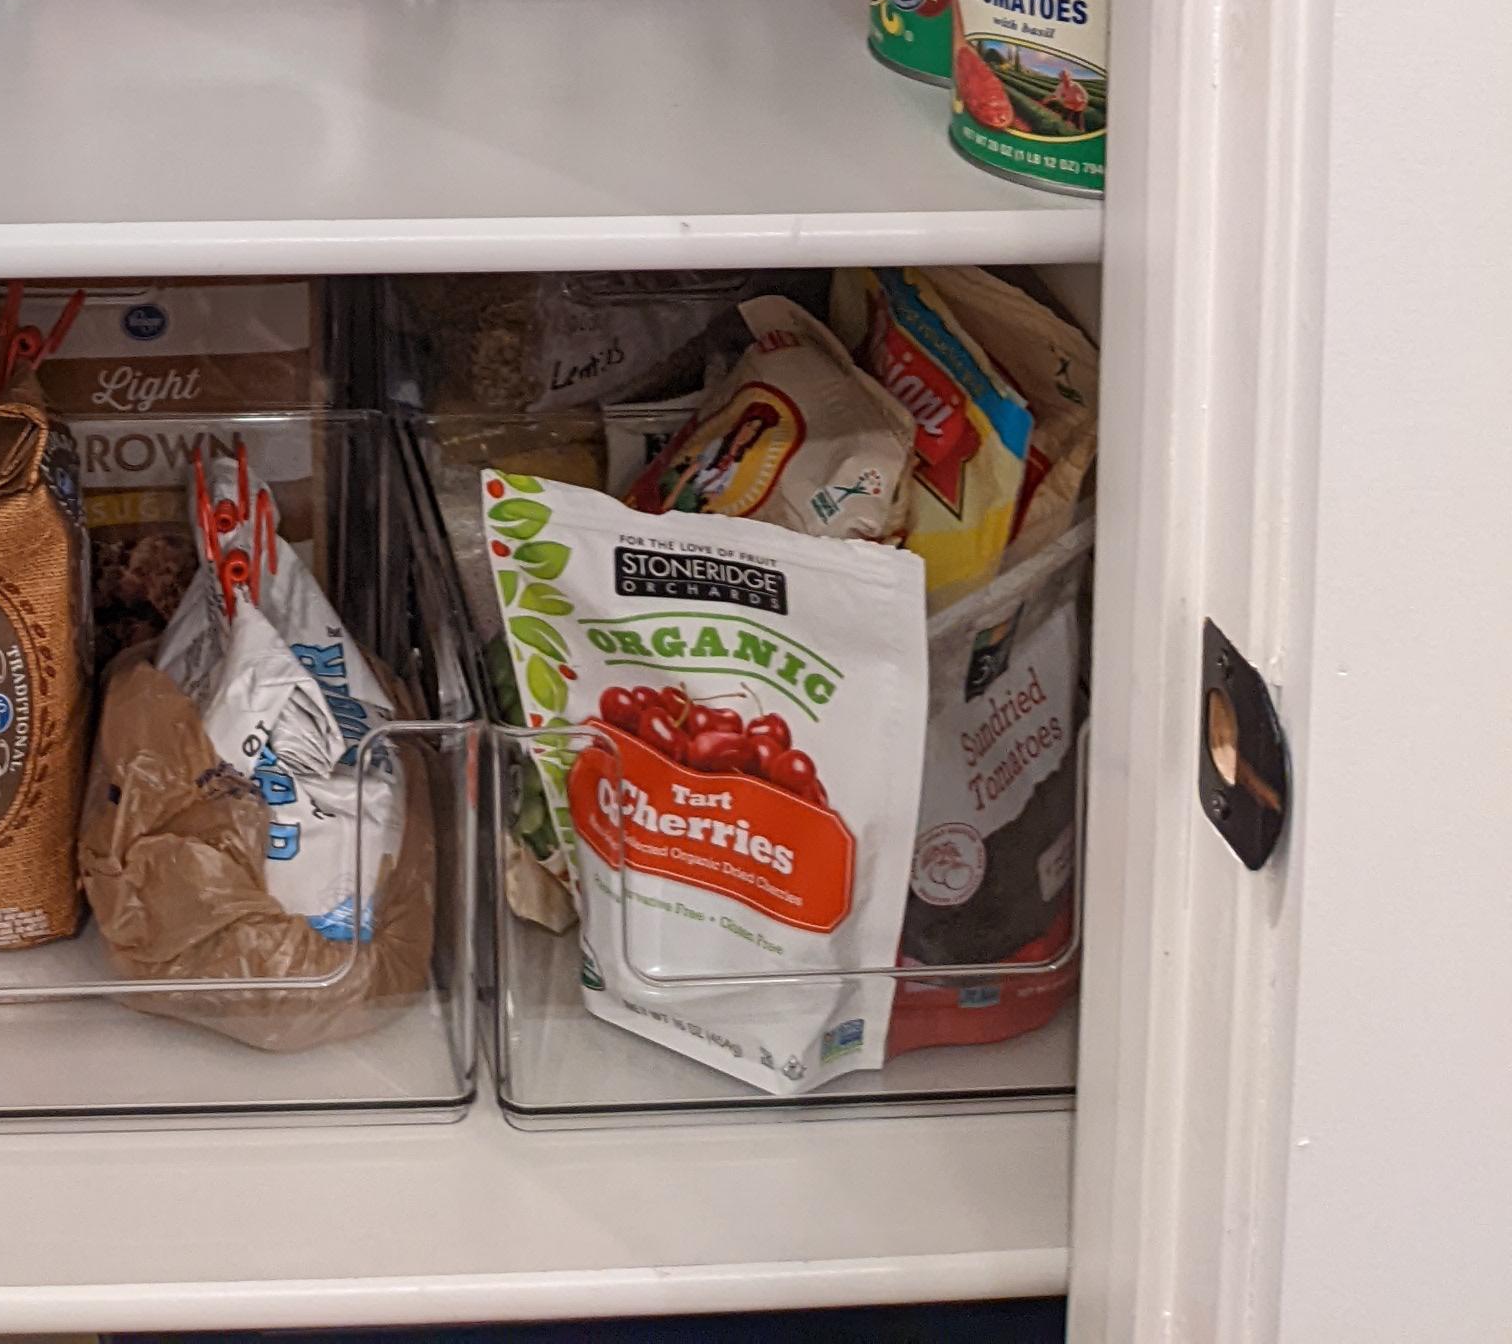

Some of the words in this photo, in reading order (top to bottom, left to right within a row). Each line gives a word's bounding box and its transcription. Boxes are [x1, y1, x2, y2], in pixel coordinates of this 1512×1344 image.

[992, 16, 1019, 31] with
[1021, 18, 1056, 39] basil
[91, 364, 202, 412] Light
[619, 534, 645, 546] FOR
[648, 538, 674, 551] THE
[679, 542, 712, 555] LOVE
[717, 547, 735, 558] OF
[739, 552, 778, 568] FRUIT
[621, 551, 778, 594] STONERIDGE
[621, 579, 781, 610] ORCHARDS
[586, 625, 836, 706] ORGANIC
[5, 644, 25, 773] TRADITIONAL
[960, 667, 1047, 769] Sundried
[968, 715, 1064, 813] Tomatoes
[671, 783, 733, 810] Tart
[598, 777, 794, 876] Cherries
